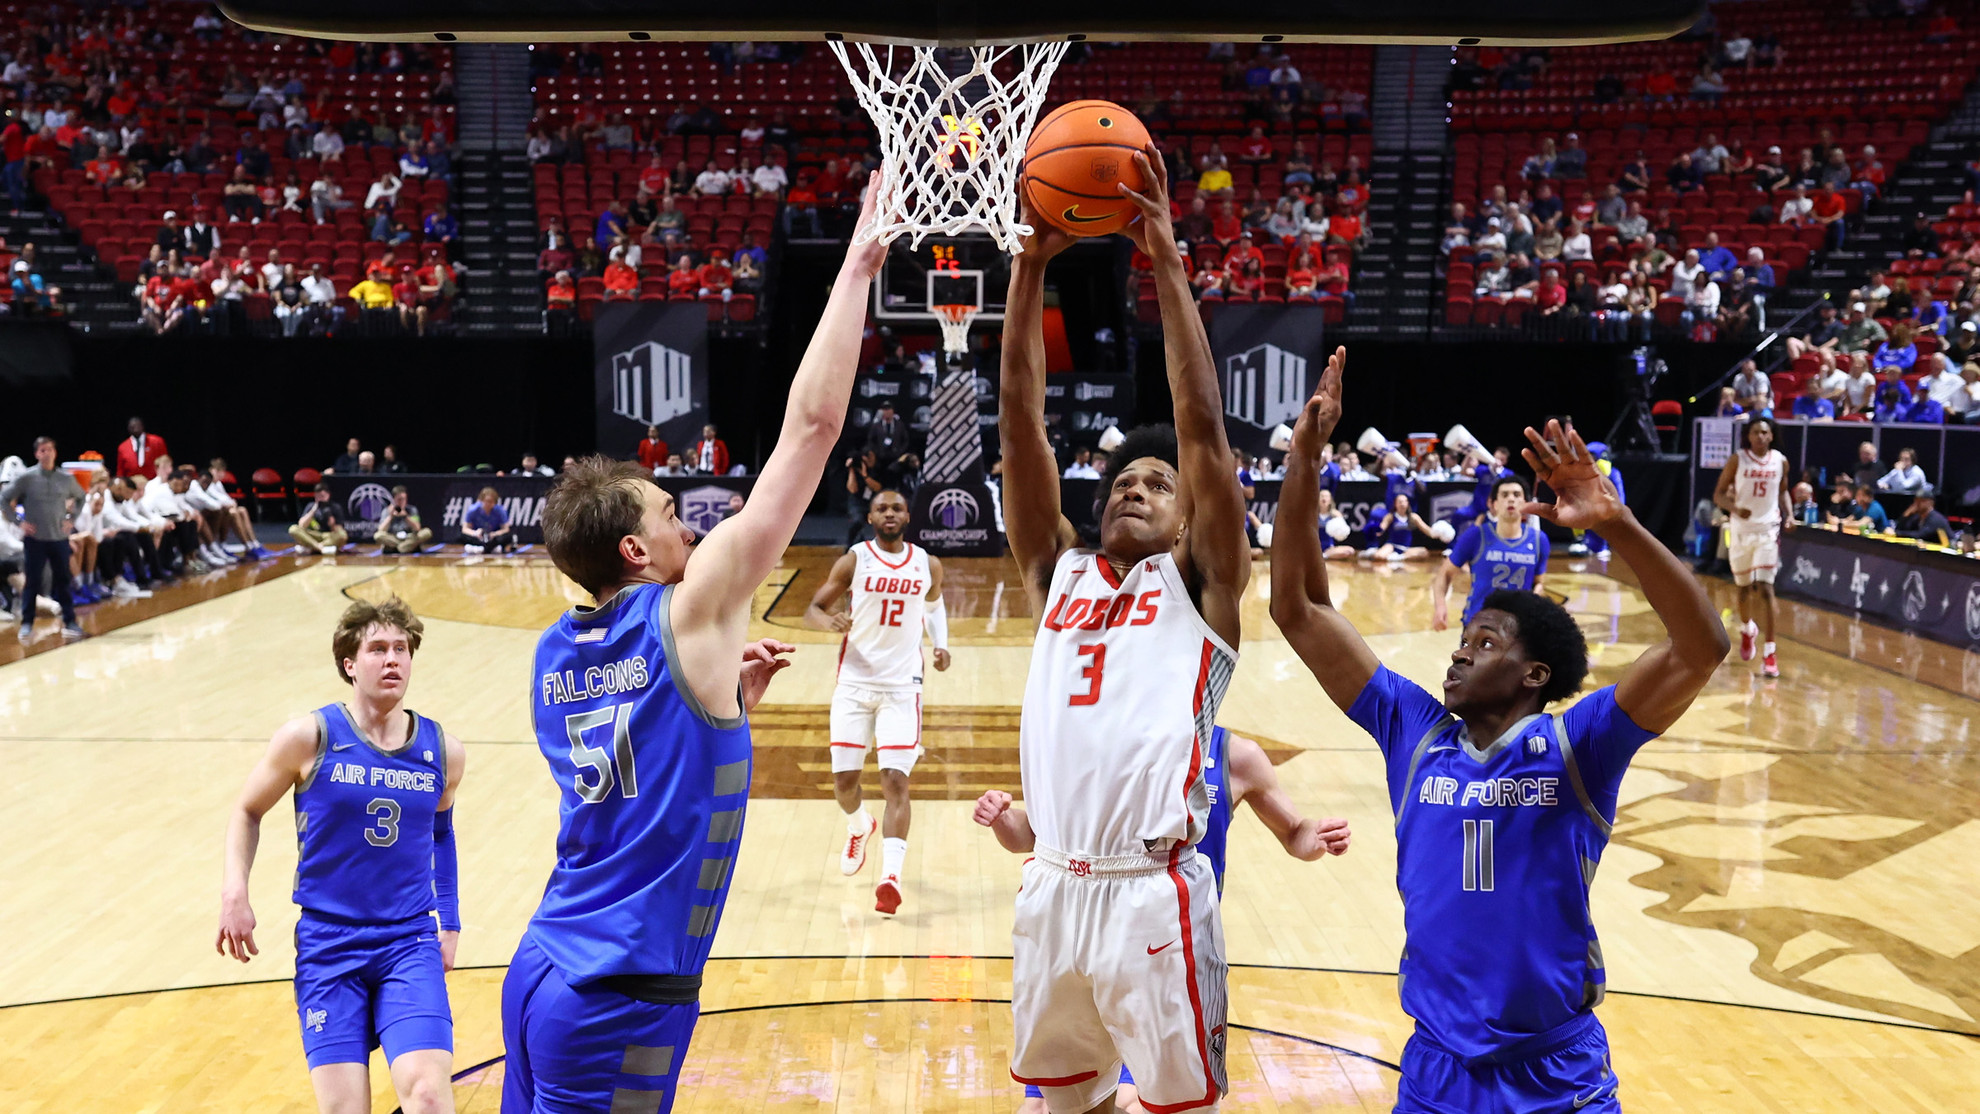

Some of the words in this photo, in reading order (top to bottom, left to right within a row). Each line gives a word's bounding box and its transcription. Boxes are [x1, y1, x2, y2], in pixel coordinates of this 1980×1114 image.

[1752, 481, 1768, 497] 15
[919, 529, 989, 541] CHAMPIONSHIPS
[864, 576, 923, 596] LOBOS
[1492, 563, 1527, 590] 24
[880, 599, 905, 627] 12
[1044, 588, 1162, 632] LOBOS
[543, 655, 649, 706] FALCONS
[1067, 642, 1106, 707] 3
[565, 702, 639, 804] 51
[330, 763, 366, 785] AIR
[370, 767, 436, 792] FORCE
[1419, 776, 1459, 806] AIR
[1461, 777, 1559, 807] FORCE
[364, 797, 401, 848] 3
[1462, 819, 1495, 892] 11
